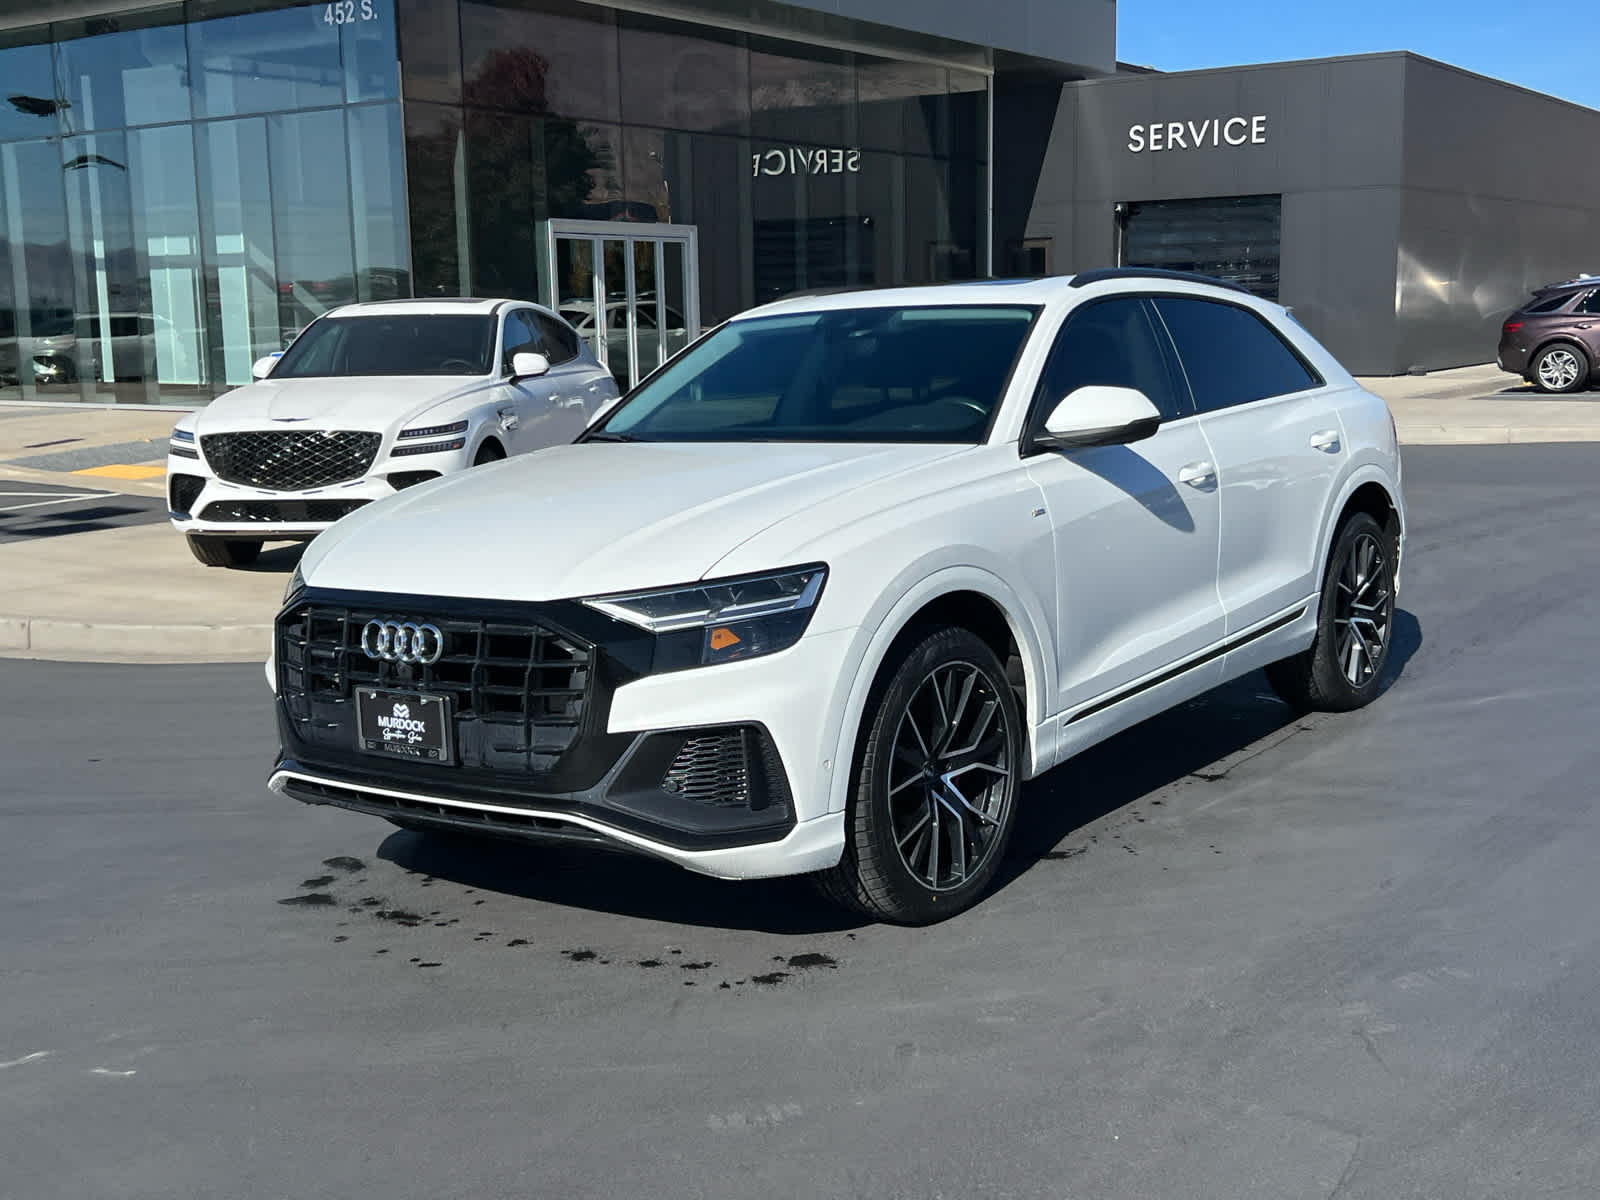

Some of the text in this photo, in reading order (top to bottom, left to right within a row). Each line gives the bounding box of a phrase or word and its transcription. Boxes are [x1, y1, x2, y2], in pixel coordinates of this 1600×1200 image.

[324, 0, 377, 25] 452 S.
[1127, 115, 1266, 152] SERVICE
[377, 715, 425, 733] MURDOCK
